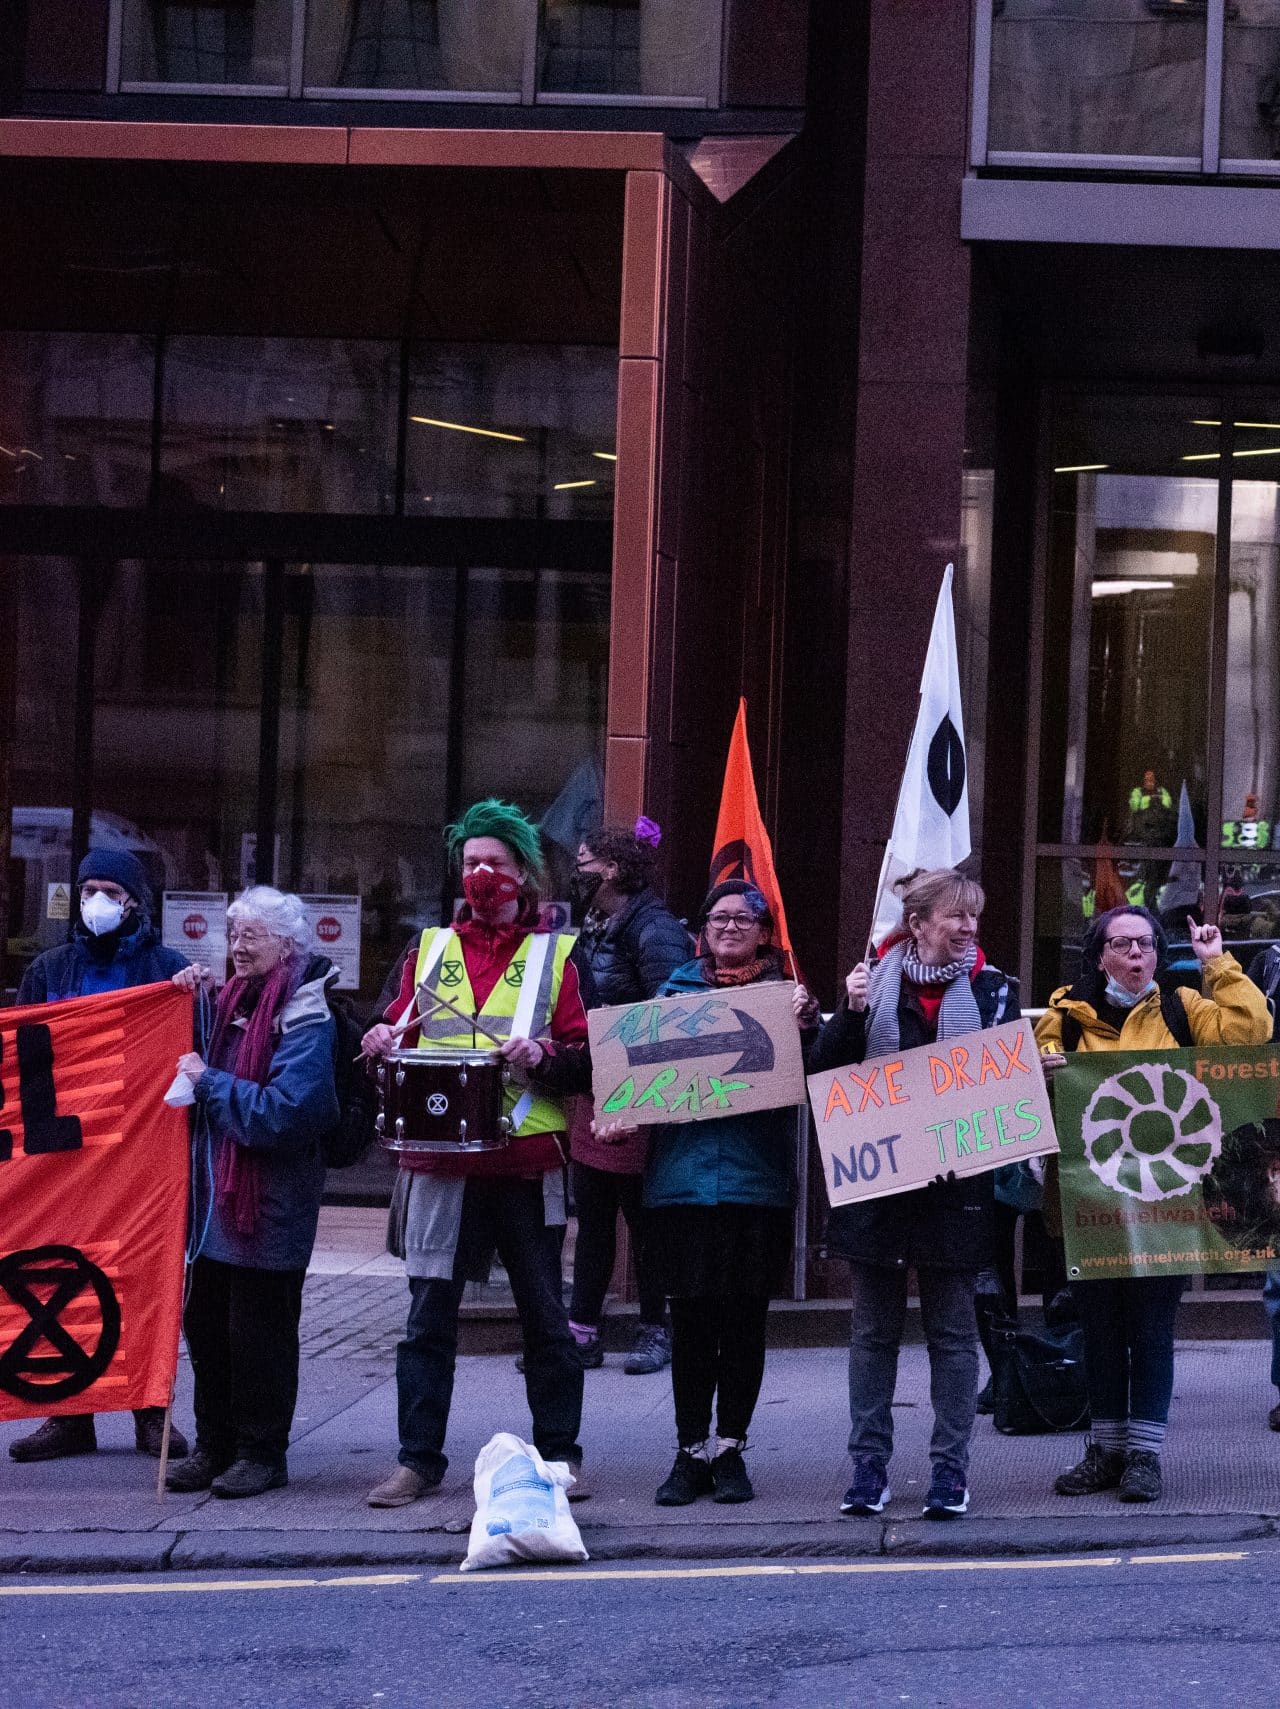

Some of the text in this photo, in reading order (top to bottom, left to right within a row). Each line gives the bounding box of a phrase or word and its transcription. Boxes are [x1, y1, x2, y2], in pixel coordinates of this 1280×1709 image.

[185, 922, 207, 933] STOP
[318, 925, 340, 935] STOP
[597, 1000, 728, 1044] AXE
[0, 1022, 83, 1161] L
[602, 1066, 754, 1113] DRAX
[823, 1032, 1032, 1122] AXE DRAX
[831, 1099, 1042, 1188] NOT TREES
[1076, 1201, 1237, 1227] biofuelwatch
[1080, 1246, 1277, 1268] wwwbiofuelwatch.org.uk
